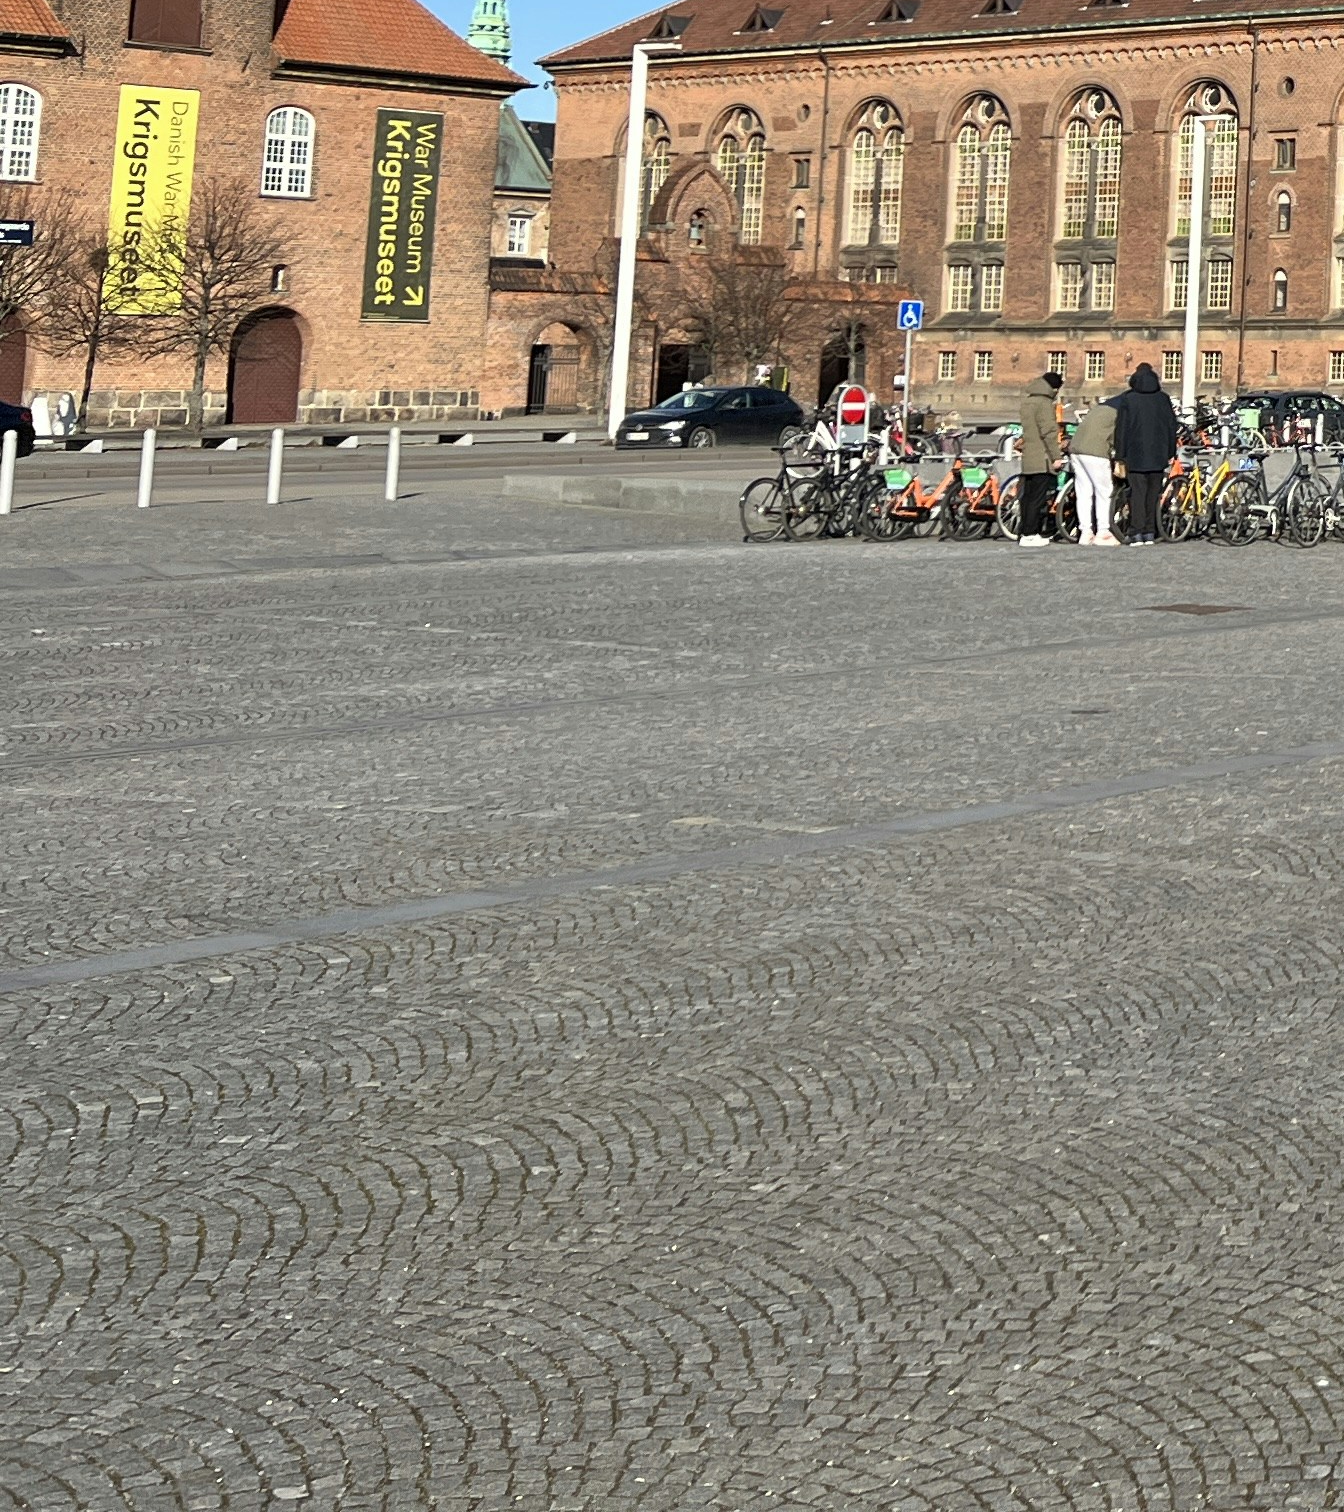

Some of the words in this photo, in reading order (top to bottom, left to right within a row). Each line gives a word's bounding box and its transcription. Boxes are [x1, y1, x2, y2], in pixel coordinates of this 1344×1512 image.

[167, 101, 189, 166] Danish
[414, 123, 437, 169] War
[120, 98, 161, 297] Krigsmuseet
[164, 172, 183, 207] War
[374, 119, 412, 305] Krigsmuseet
[406, 173, 433, 273] Museum
